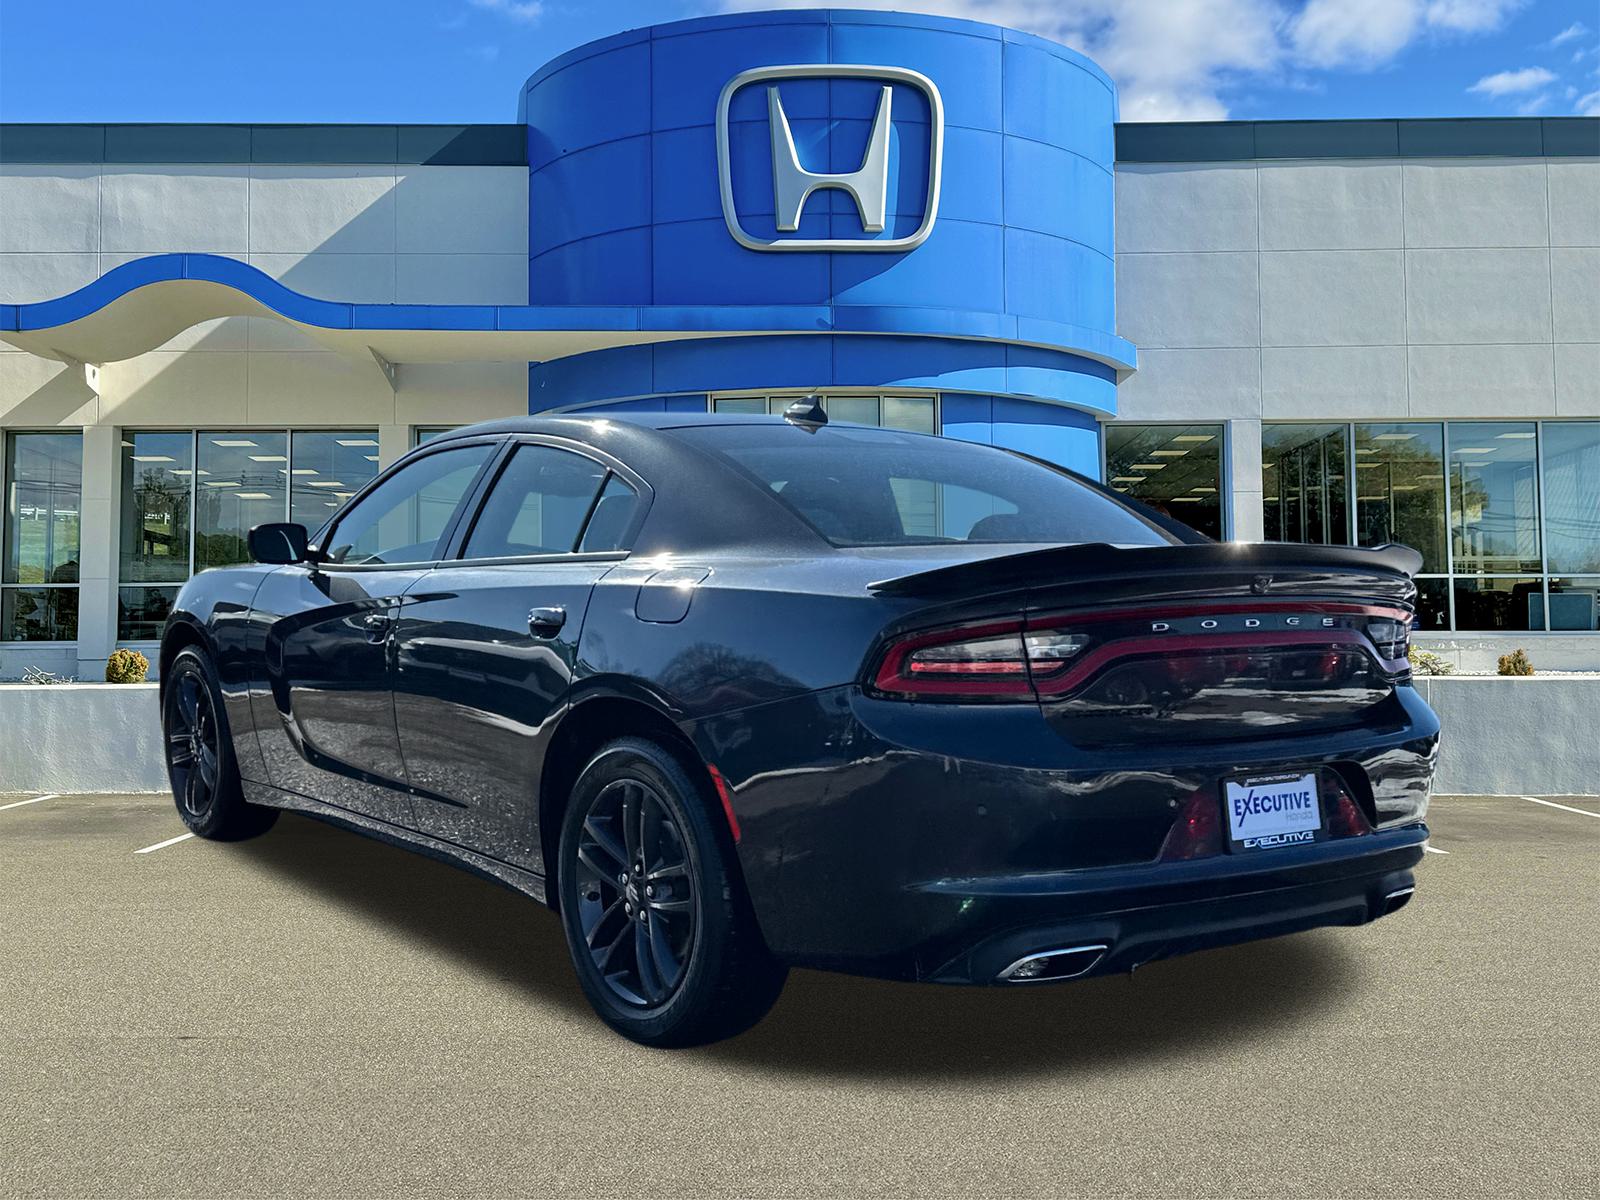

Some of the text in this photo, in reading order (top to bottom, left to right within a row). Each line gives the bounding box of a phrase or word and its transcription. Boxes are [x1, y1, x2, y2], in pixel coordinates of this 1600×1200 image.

[1152, 617, 1335, 631] DODGE
[1234, 790, 1311, 827] EXECUTIVE
[1243, 831, 1314, 848] EXECUTIVE
